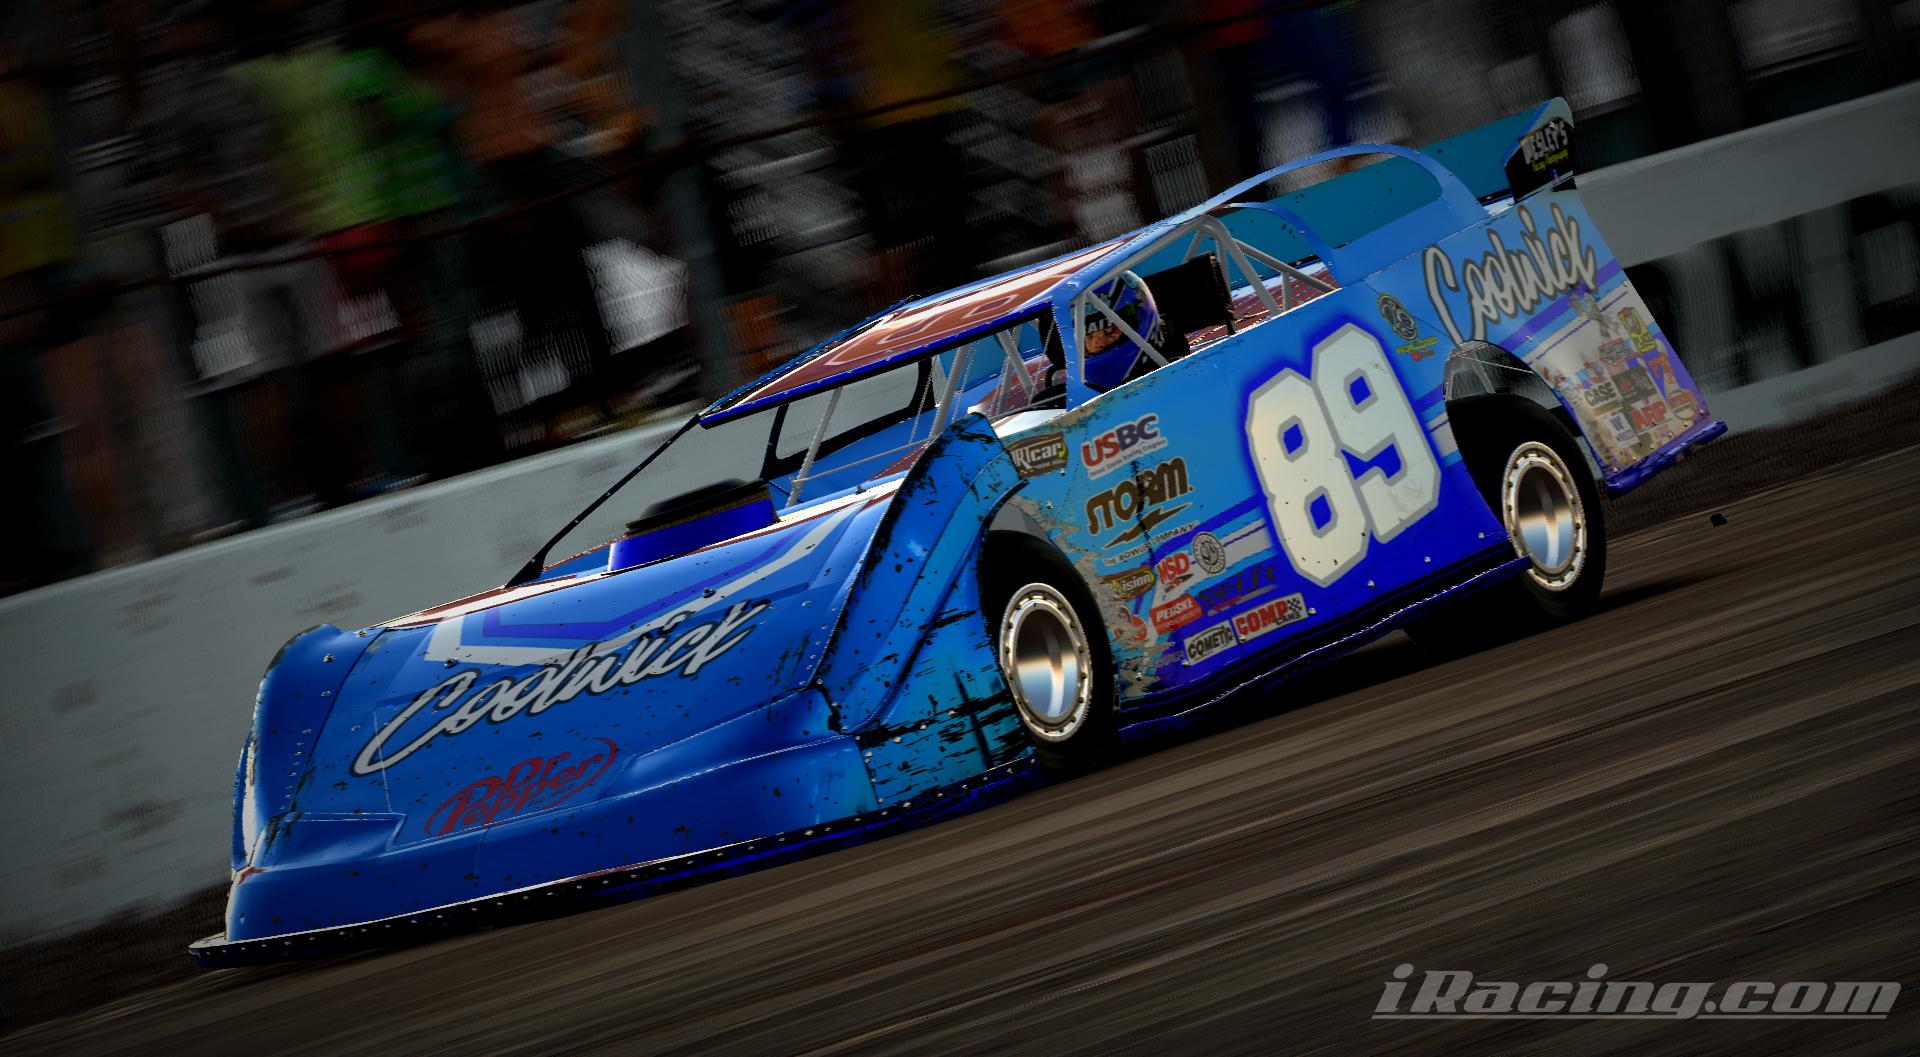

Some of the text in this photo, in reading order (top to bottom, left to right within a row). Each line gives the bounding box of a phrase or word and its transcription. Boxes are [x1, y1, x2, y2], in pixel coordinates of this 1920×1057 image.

[1582, 380, 1617, 408] CASE
[1082, 414, 1159, 468] USBC
[1246, 322, 1441, 588] 89
[1086, 457, 1188, 534] STORM
[1187, 626, 1234, 659] COMETIC
[1235, 600, 1289, 637] COMP
[350, 599, 771, 777] Coolwick
[437, 752, 606, 836] Pepper
[505, 751, 571, 788] Dr
